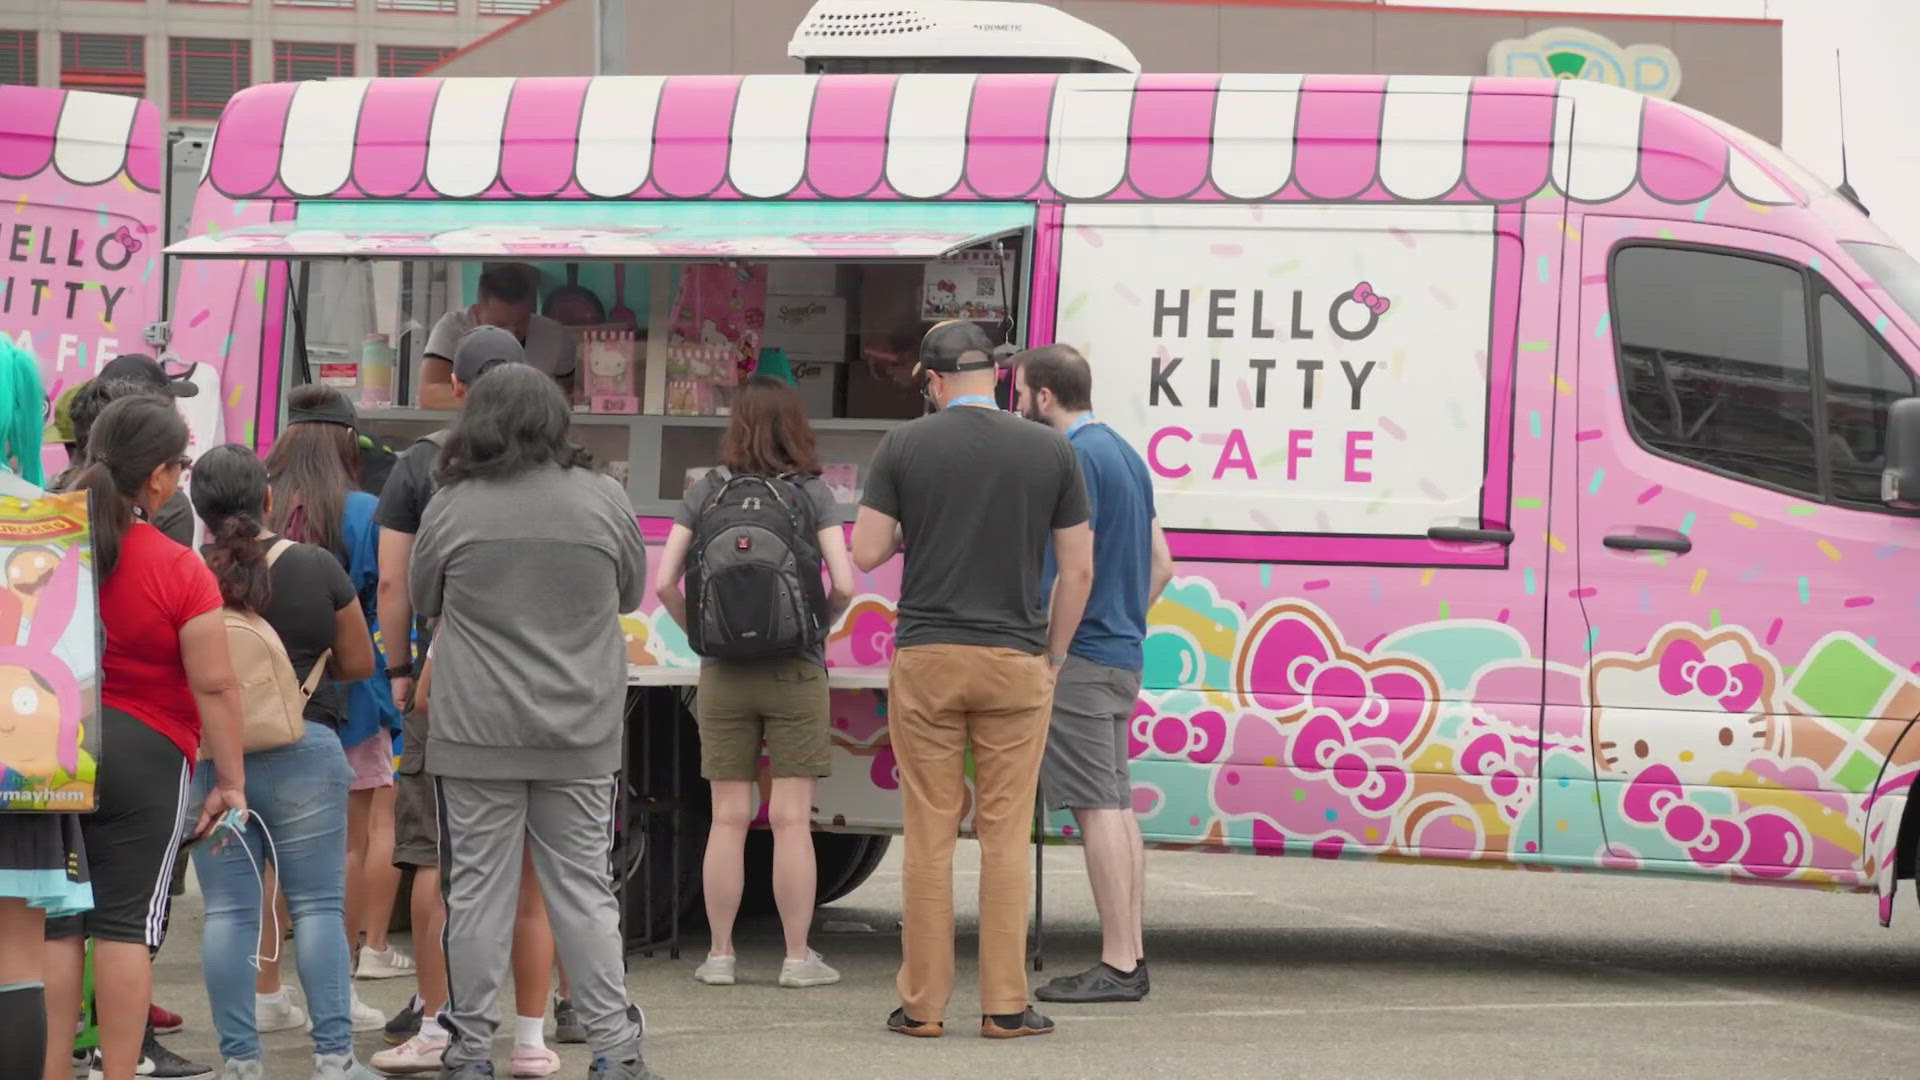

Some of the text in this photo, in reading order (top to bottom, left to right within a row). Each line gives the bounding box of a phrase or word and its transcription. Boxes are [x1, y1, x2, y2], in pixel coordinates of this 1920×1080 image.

[0, 223, 132, 272] ELLO
[1153, 288, 1380, 342] HELLO
[1149, 357, 1377, 410] KITTY
[1147, 426, 1374, 483] CAFE
[0, 787, 85, 804] mayhem
